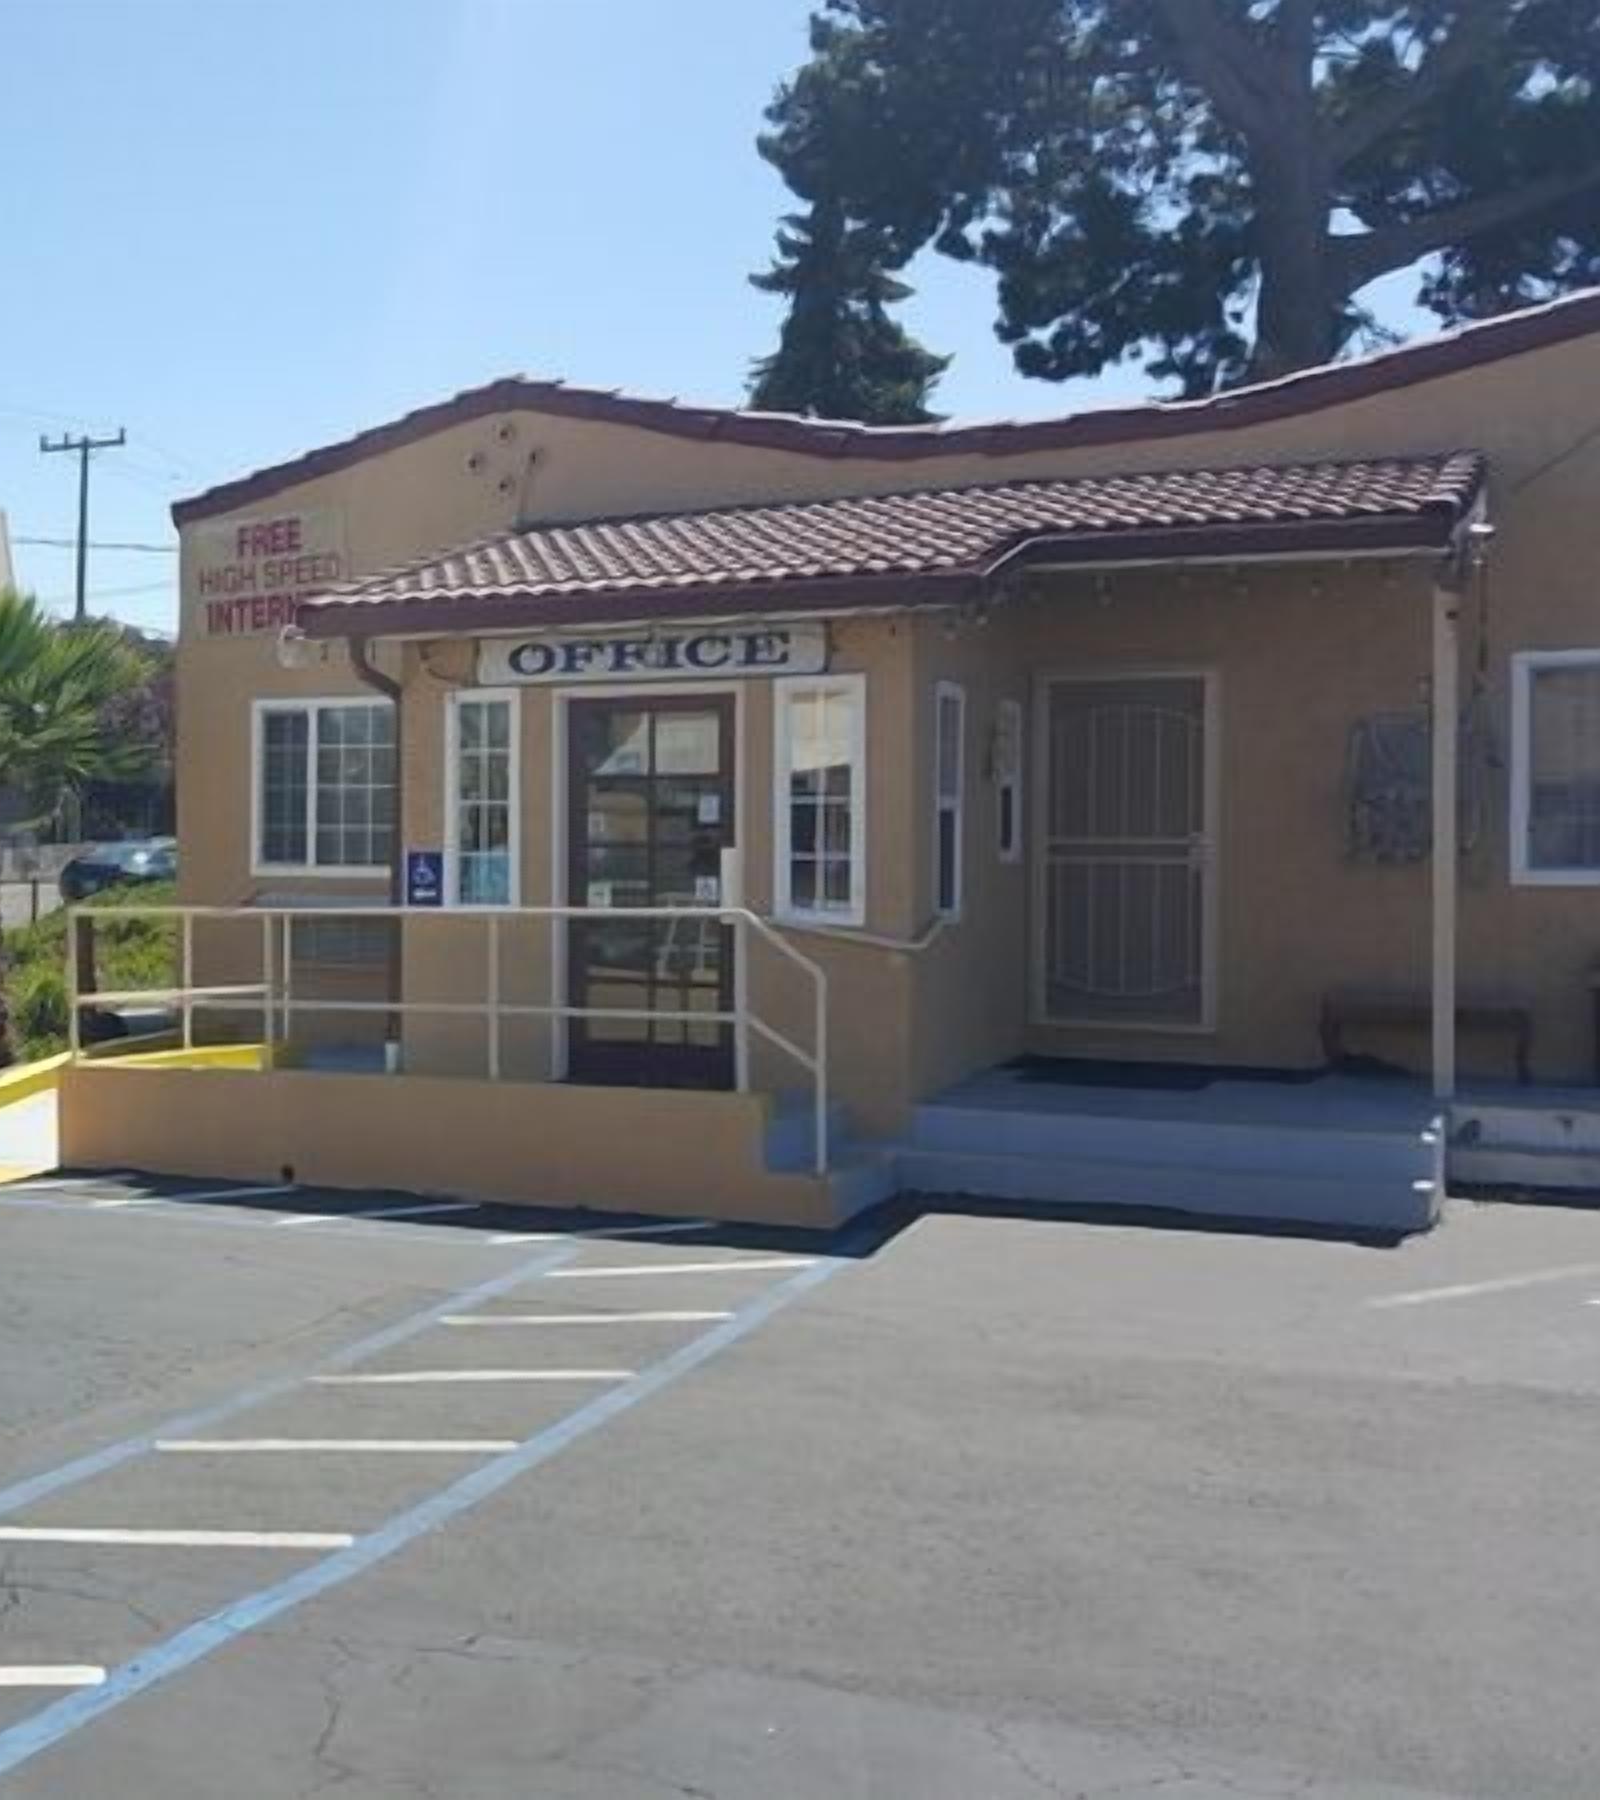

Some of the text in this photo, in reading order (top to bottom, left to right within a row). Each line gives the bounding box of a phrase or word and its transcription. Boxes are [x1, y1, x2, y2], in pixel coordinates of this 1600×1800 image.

[238, 519, 302, 557] FREE
[200, 553, 341, 593] HIGH SPEED
[508, 632, 789, 675] OFFICE
